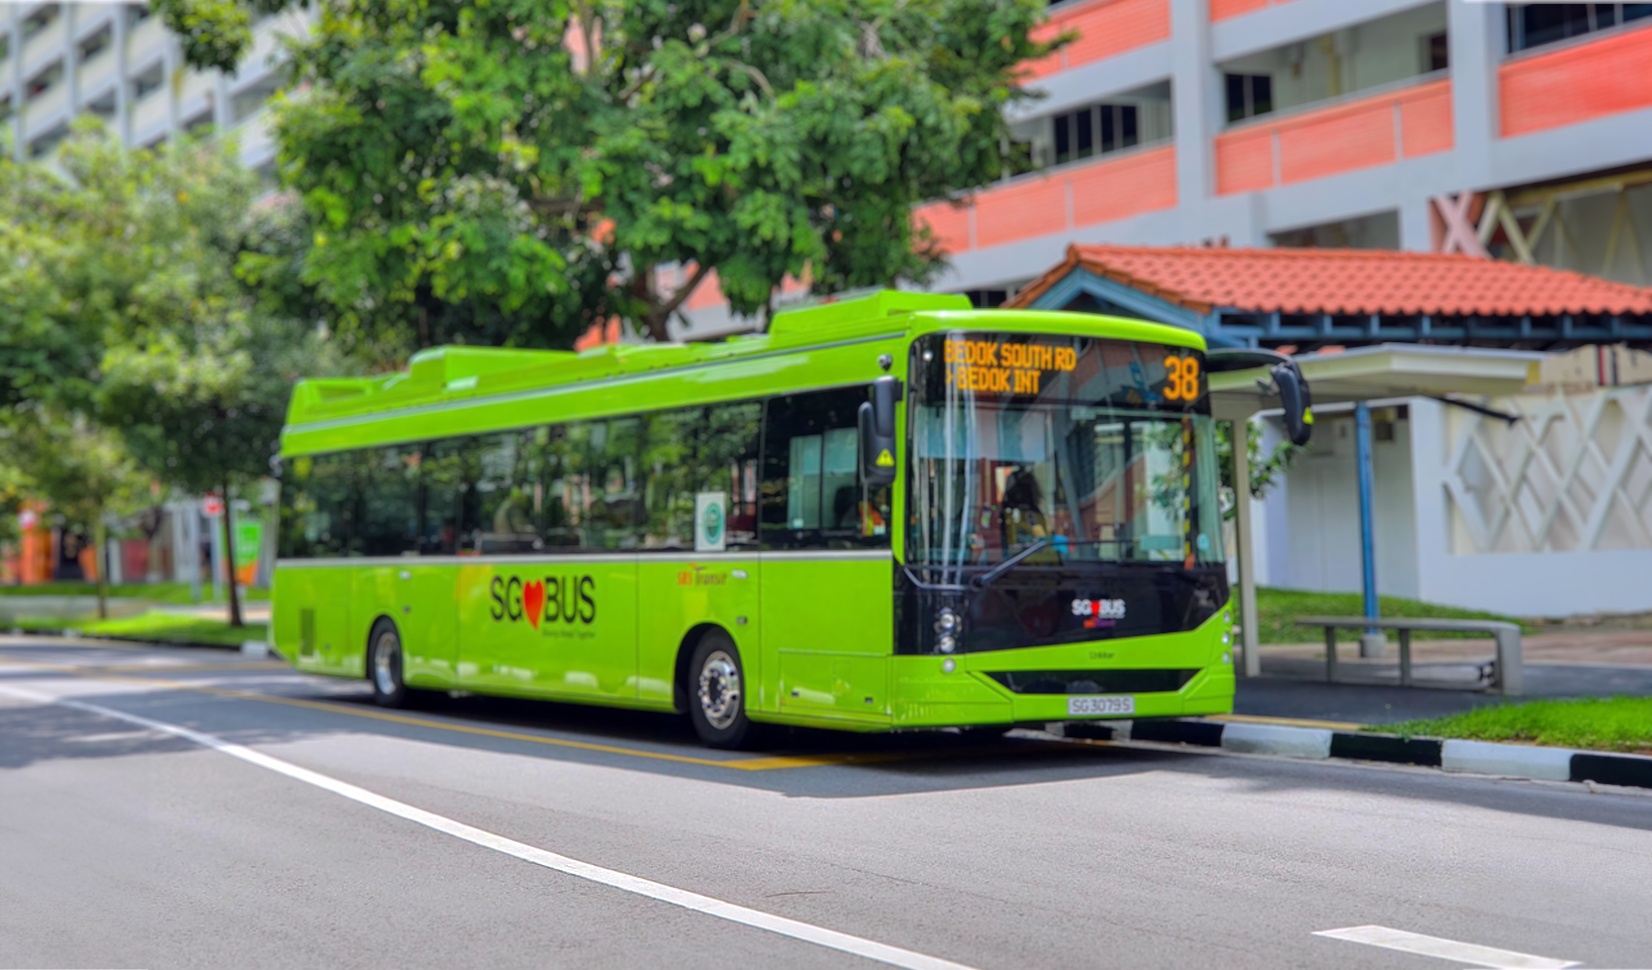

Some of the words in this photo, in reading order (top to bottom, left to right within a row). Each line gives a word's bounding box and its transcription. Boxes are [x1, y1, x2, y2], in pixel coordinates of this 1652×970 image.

[944, 340, 999, 366] BEDOK
[1000, 344, 1051, 370] SOUTH
[1054, 347, 1076, 371] RD
[957, 367, 1011, 392] BEDOK
[1013, 370, 1041, 395] INT
[1163, 355, 1199, 400] 38
[544, 576, 596, 624] BUS
[1098, 599, 1126, 616] BUS
